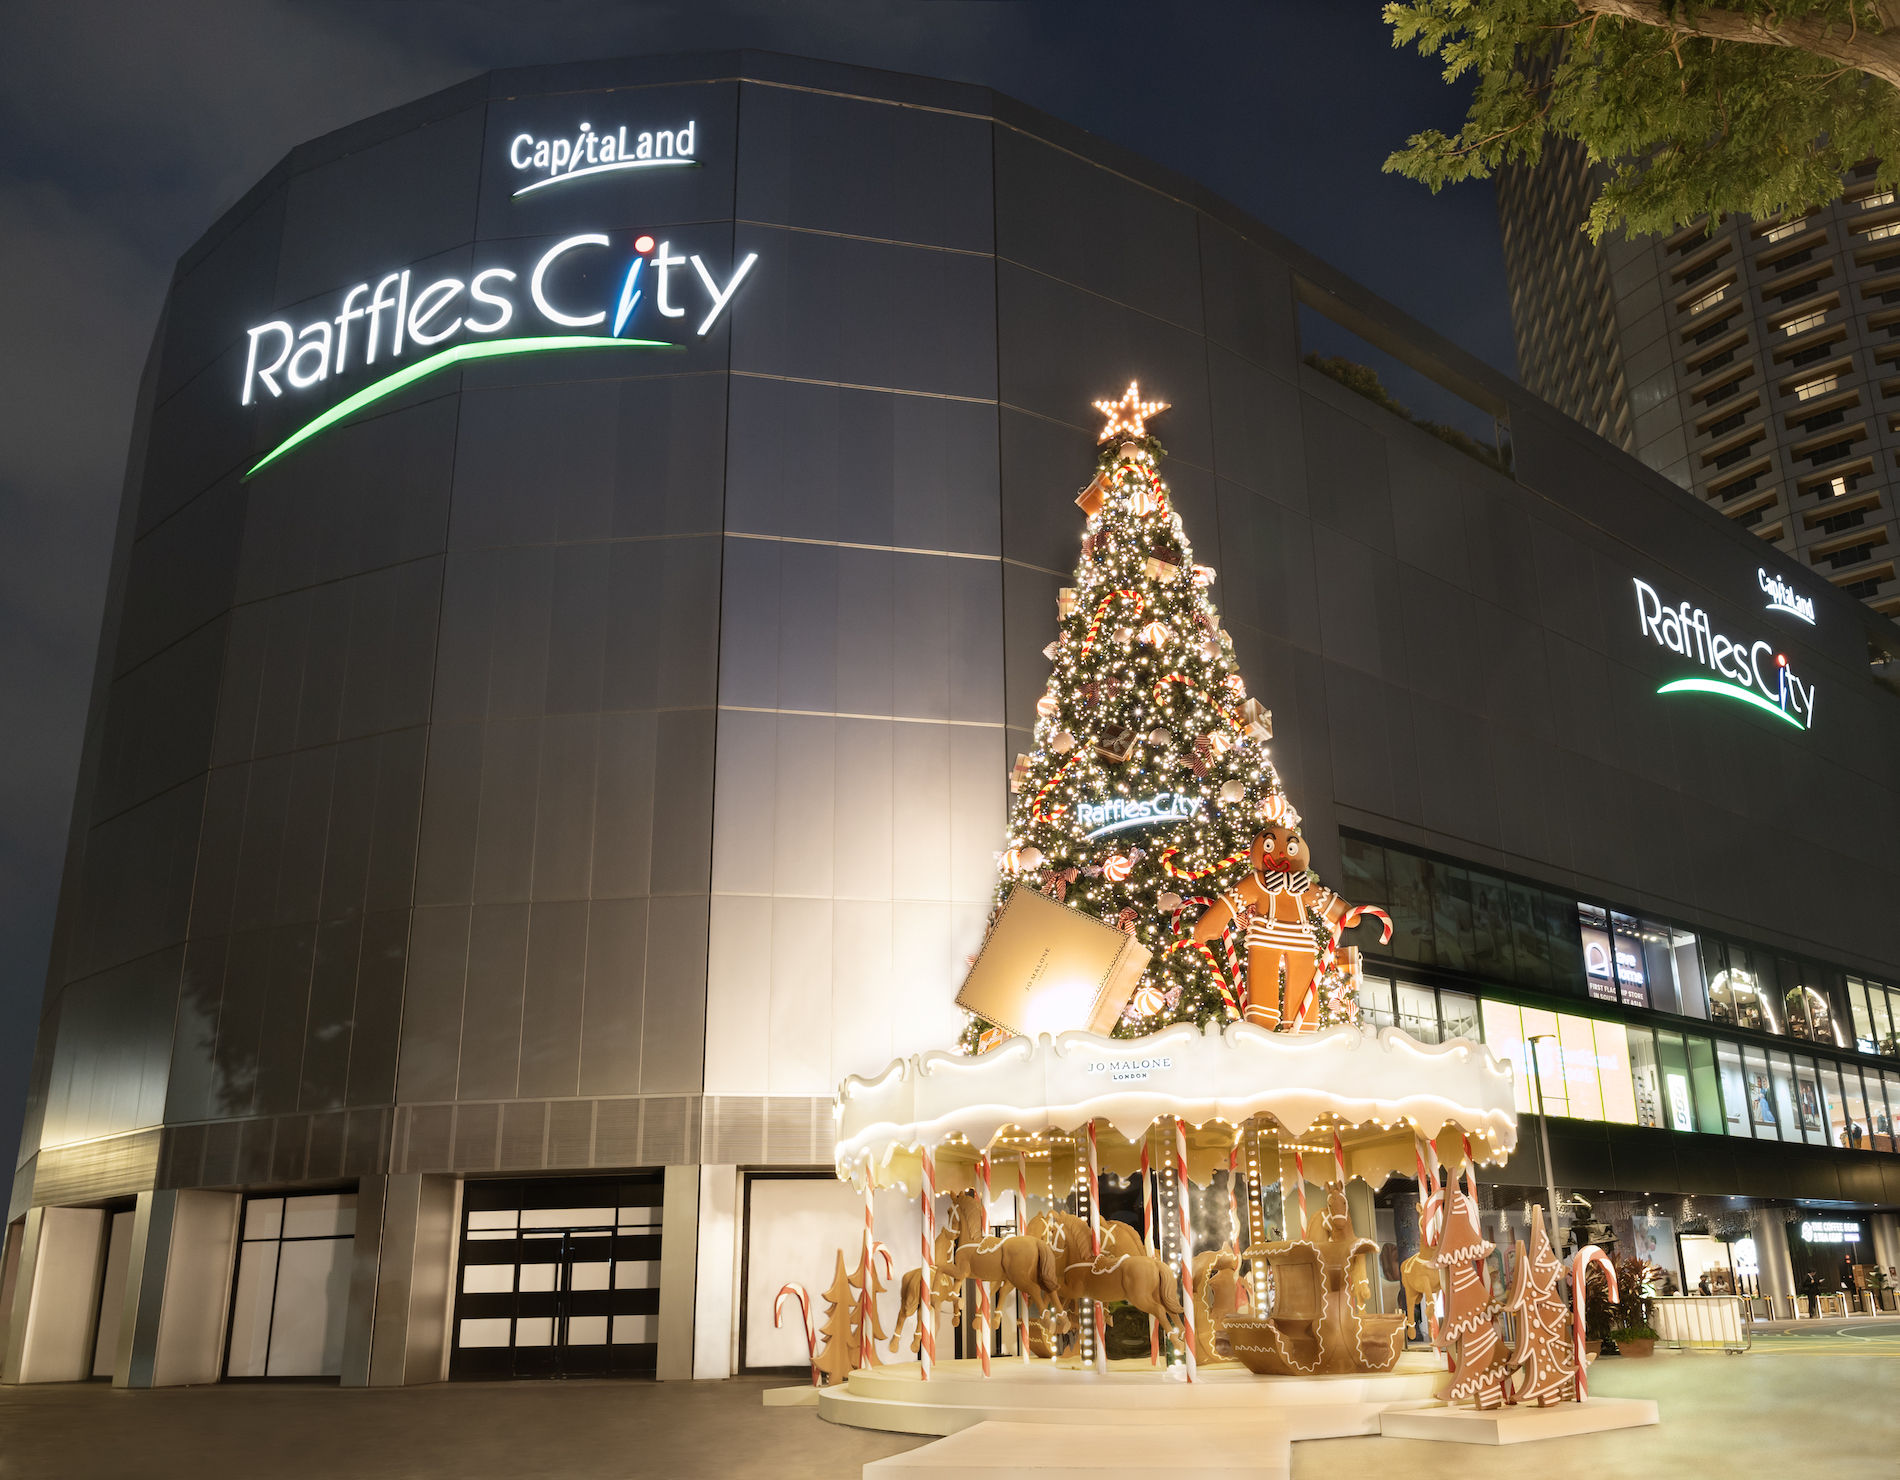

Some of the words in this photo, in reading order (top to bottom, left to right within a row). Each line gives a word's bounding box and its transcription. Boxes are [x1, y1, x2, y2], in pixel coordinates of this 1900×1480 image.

[510, 121, 695, 175] CapitaLand
[242, 267, 517, 406] Raffles
[531, 233, 758, 338] City
[1757, 567, 1816, 620] CapitaLand
[1628, 990, 1644, 1000] STORE
[1087, 1062, 1105, 1072] JO
[1109, 1058, 1171, 1071] MALONE
[1113, 1072, 1147, 1081] LONDON
